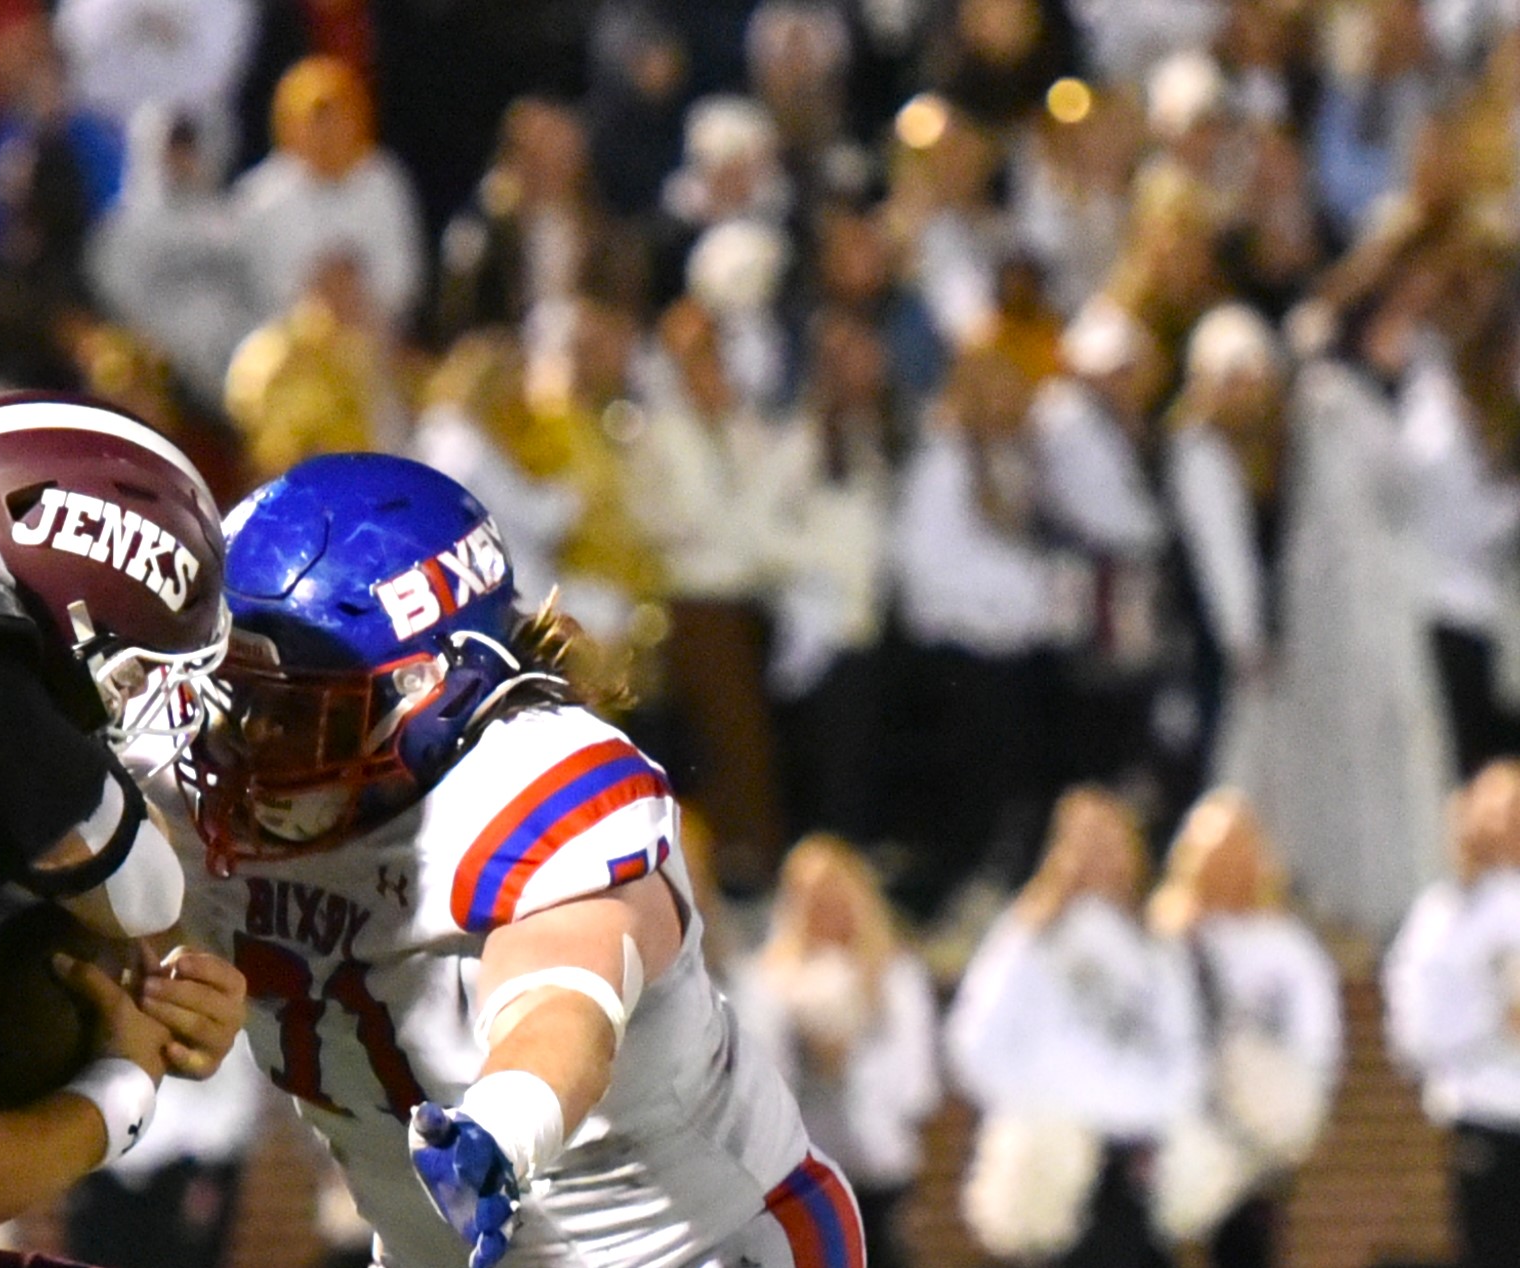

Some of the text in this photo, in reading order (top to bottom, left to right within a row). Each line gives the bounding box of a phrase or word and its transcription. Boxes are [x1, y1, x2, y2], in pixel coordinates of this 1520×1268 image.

[11, 488, 200, 613] JENKS
[245, 877, 371, 960] BIXBY
[233, 930, 442, 1126] 71
